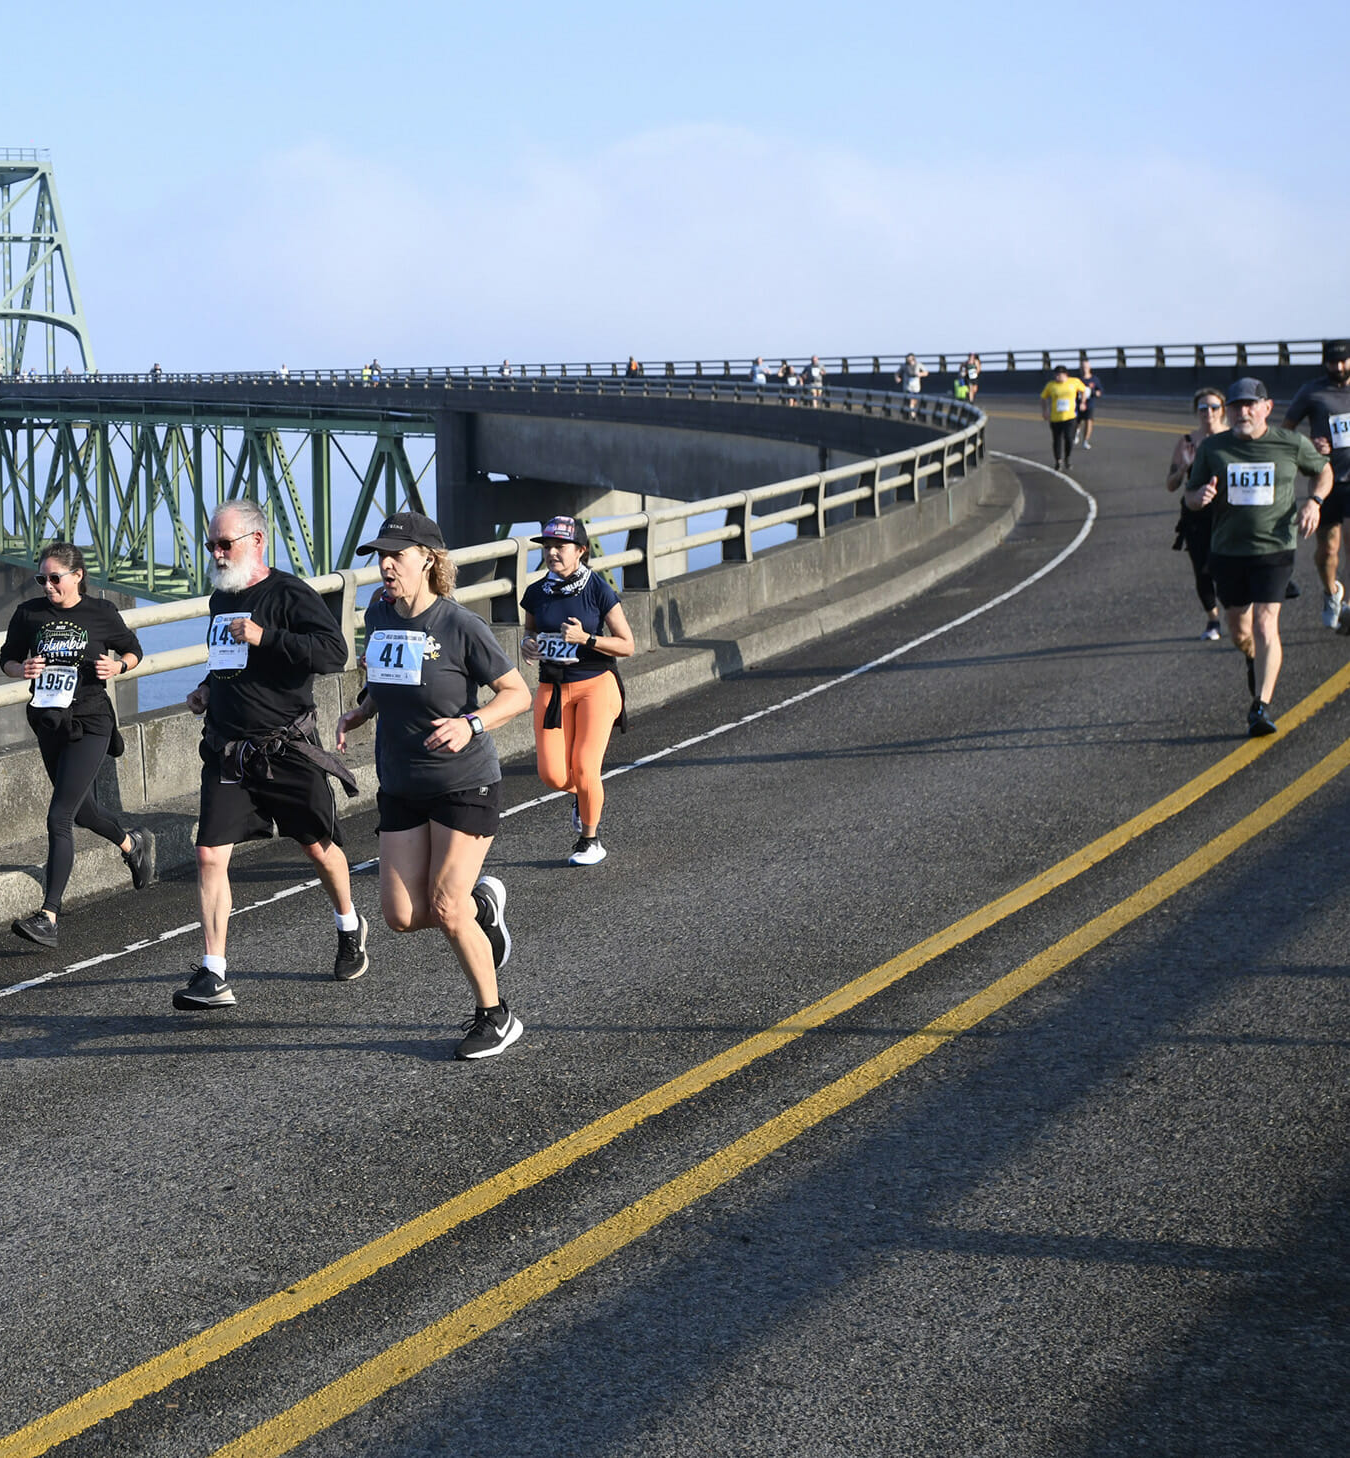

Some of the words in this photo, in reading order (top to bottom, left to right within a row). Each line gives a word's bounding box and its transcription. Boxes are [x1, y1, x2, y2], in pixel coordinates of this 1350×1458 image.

[1332, 421, 1350, 434] 13
[1229, 471, 1271, 487] 1611
[379, 643, 404, 668] 41
[538, 639, 577, 658] 2627
[37, 673, 75, 691] 1956
